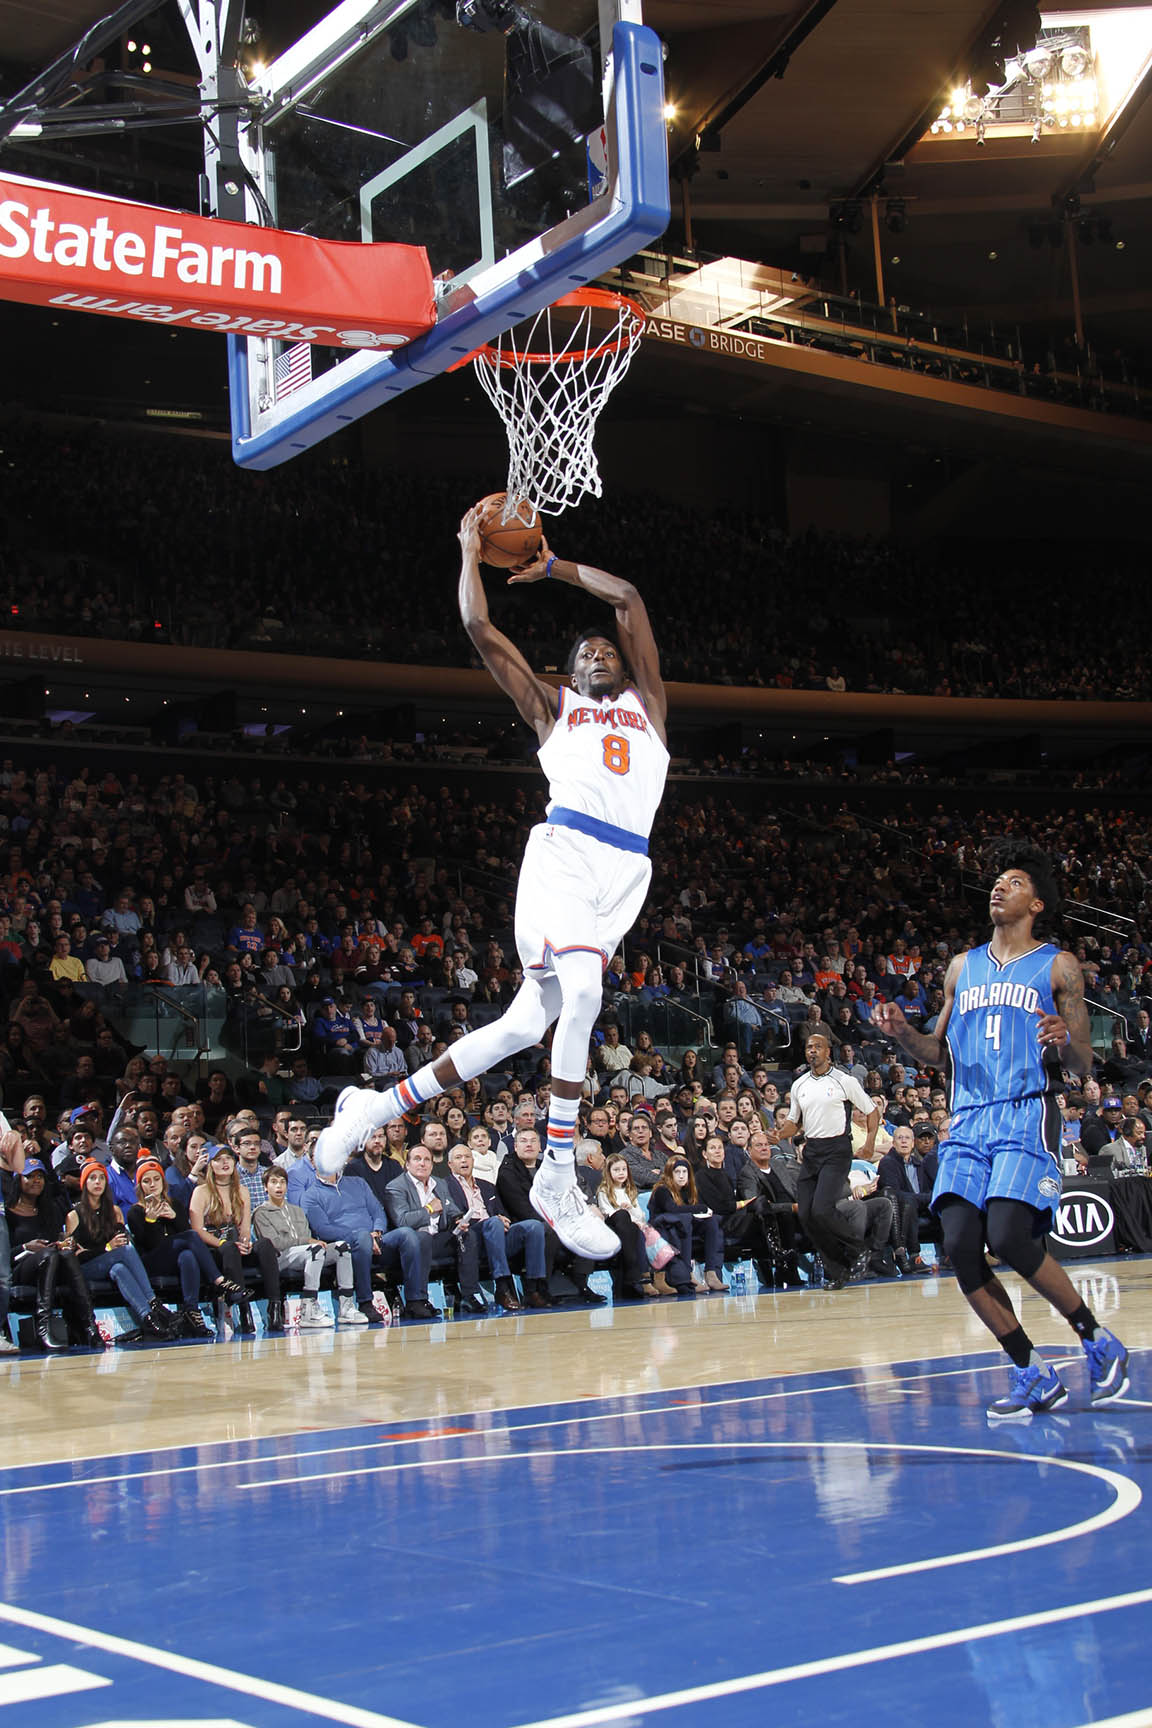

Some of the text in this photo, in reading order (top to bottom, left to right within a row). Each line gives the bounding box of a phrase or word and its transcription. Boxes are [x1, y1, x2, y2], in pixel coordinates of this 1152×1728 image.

[710, 333, 765, 359] BRIDGE
[29, 644, 83, 663] LEVEL
[568, 707, 609, 731] NEW
[601, 734, 631, 776] 8
[959, 981, 1039, 1016] ORLANDO
[985, 1013, 1002, 1051] 4
[1055, 1202, 1105, 1235] KIA
